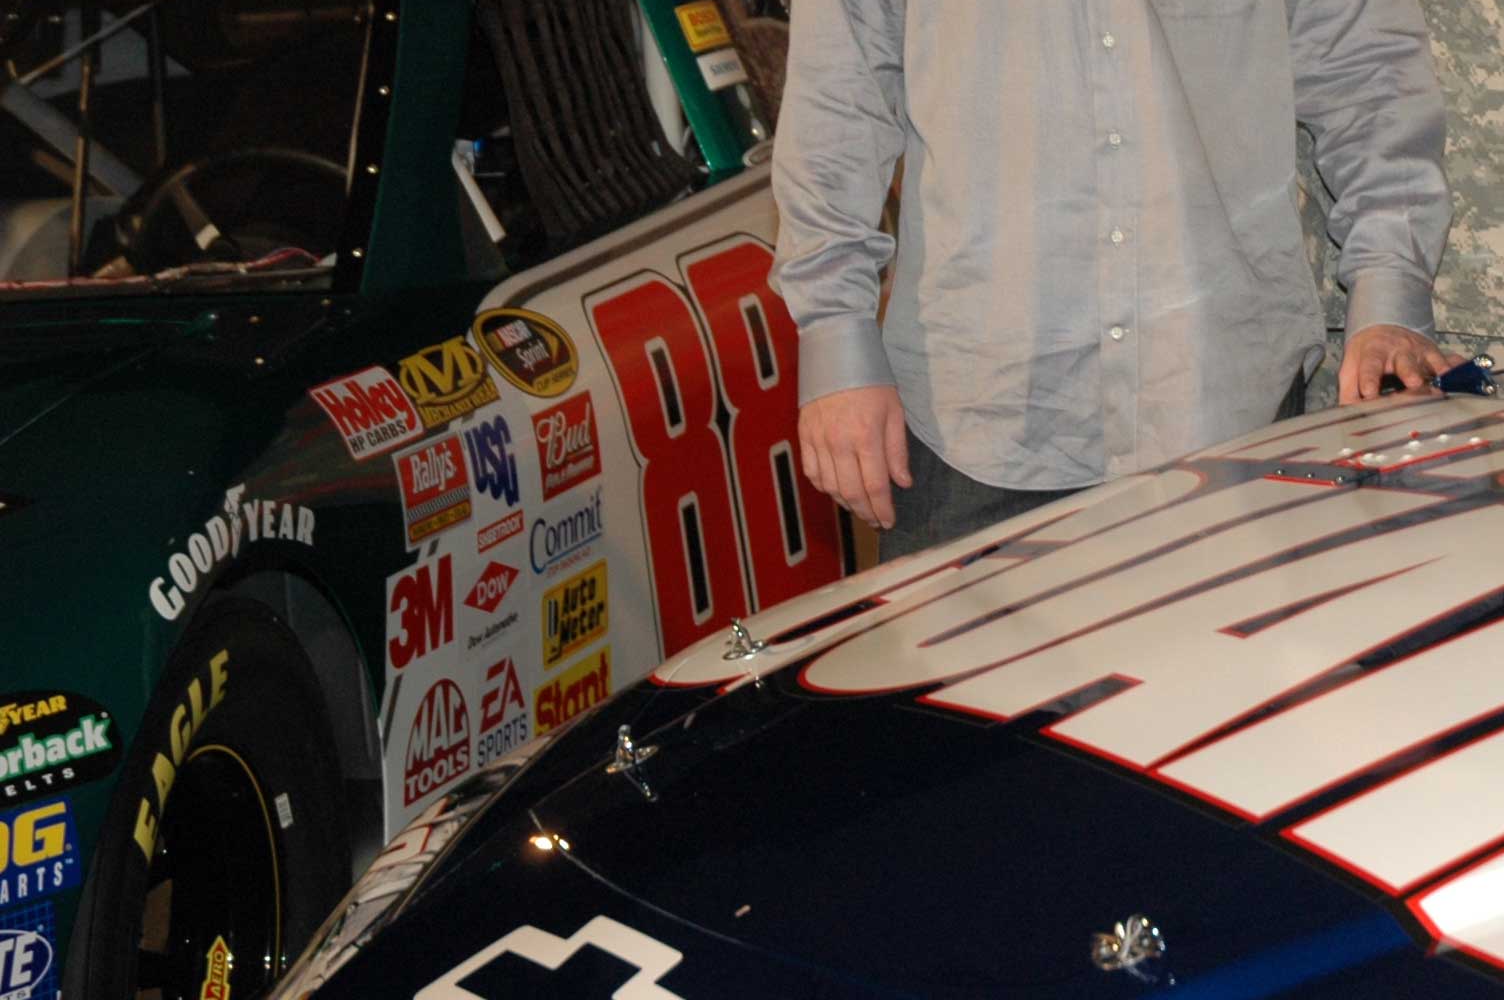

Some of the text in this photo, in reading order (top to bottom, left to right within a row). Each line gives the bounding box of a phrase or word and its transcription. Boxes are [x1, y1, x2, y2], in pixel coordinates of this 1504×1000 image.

[313, 377, 417, 432] Holley
[536, 401, 593, 469] Bud
[350, 420, 407, 452] HP CARBS
[591, 241, 843, 660] 88
[410, 442, 458, 494] Rally's
[529, 494, 602, 574] Commit
[389, 553, 453, 669] 3M
[475, 569, 510, 607] DOW
[563, 576, 596, 615] Auto
[560, 602, 604, 643] Meter
[480, 656, 525, 735] EA
[536, 652, 609, 730] Stant
[133, 648, 229, 864] EAGLE
[407, 681, 469, 771] MAC
[478, 714, 529, 768] SPORTS
[405, 749, 469, 805] TOOLS
